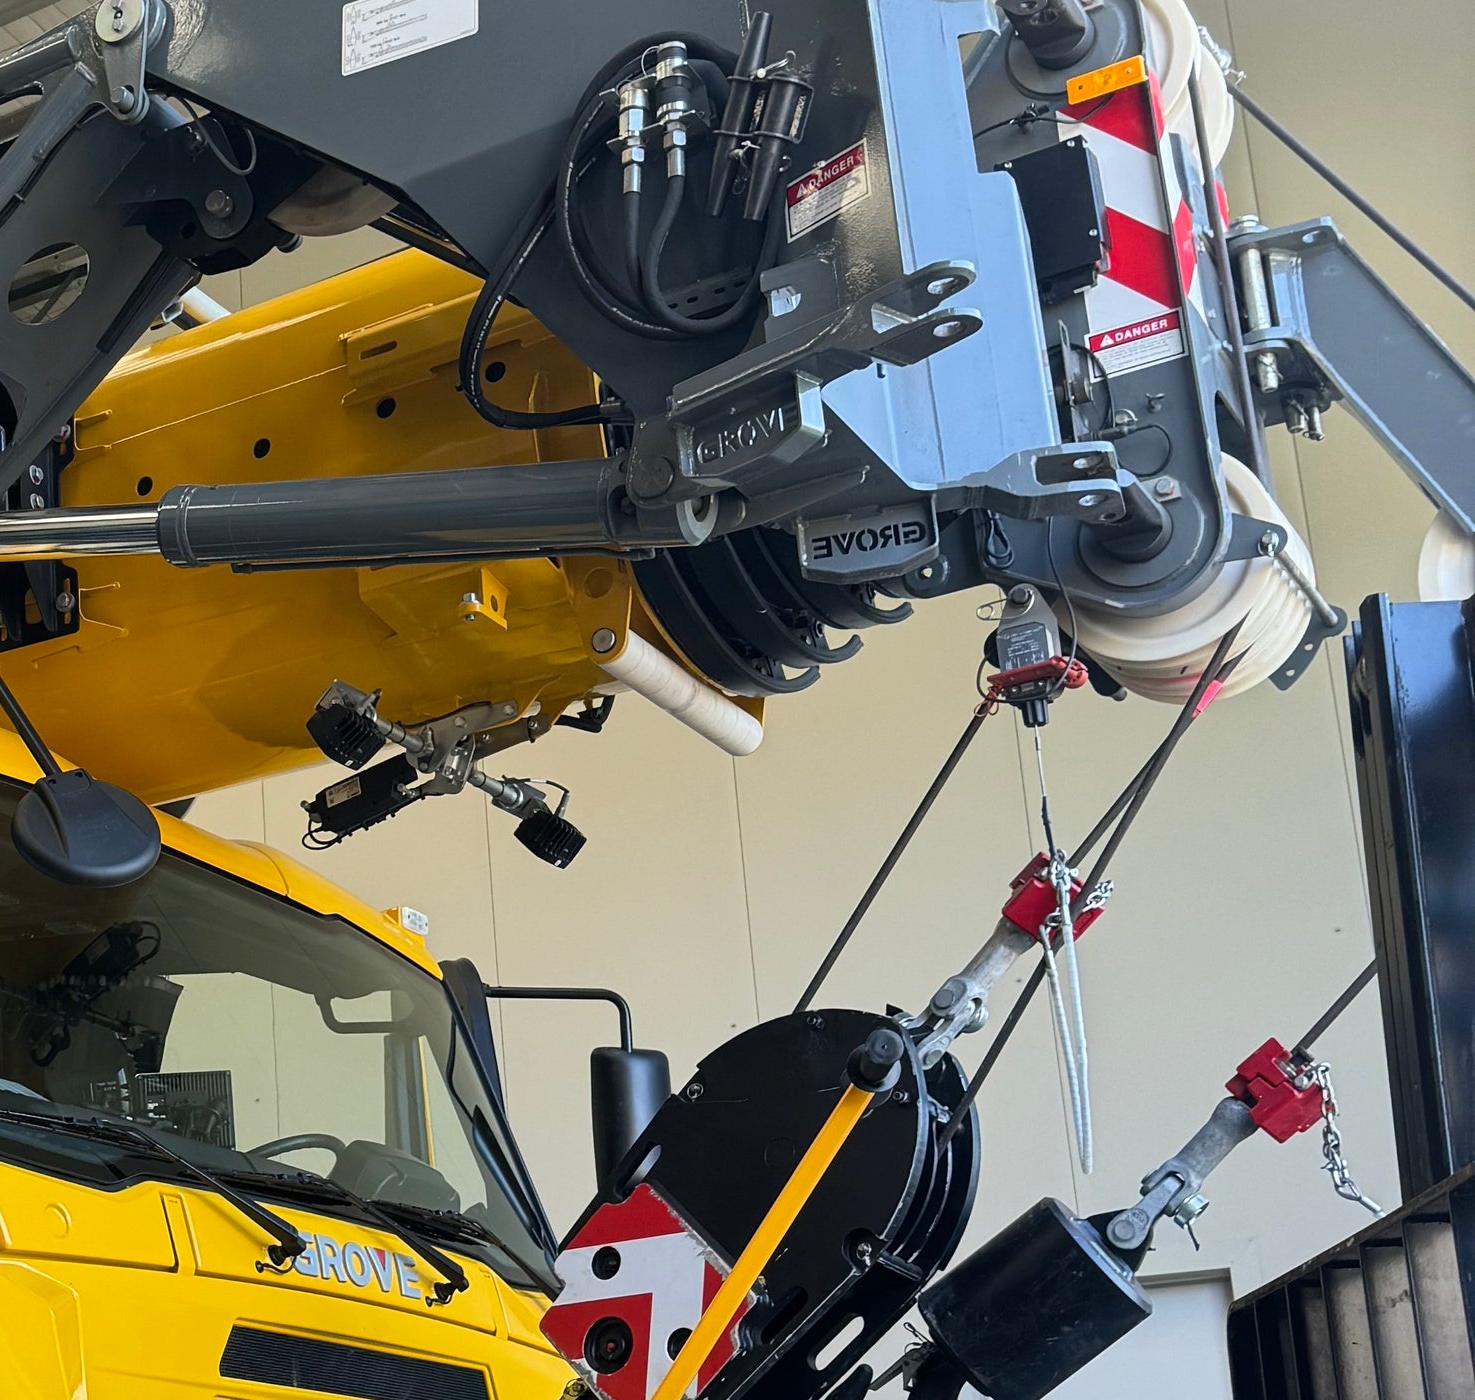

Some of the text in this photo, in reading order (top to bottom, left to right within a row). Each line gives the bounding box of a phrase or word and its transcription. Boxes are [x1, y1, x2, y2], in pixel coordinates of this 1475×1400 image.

[809, 156, 855, 187] DANGER
[1115, 318, 1168, 342] DANGER
[293, 1232, 421, 1299] GROVE
